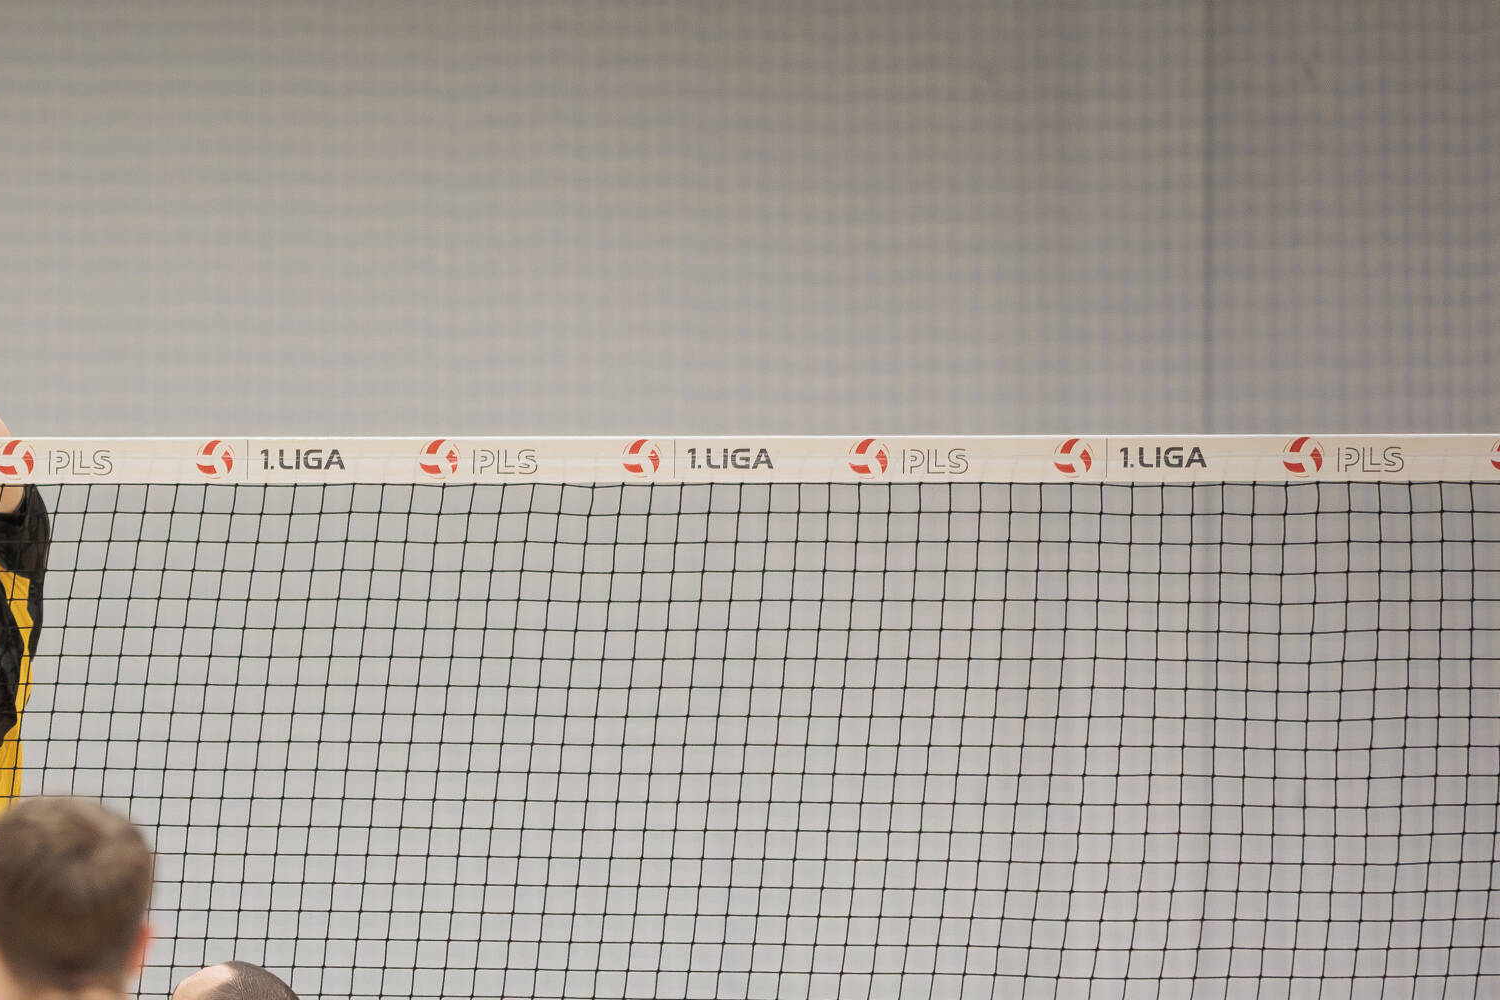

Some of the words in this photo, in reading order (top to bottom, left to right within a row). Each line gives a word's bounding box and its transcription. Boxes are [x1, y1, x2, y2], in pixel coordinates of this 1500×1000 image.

[48, 449, 114, 476] PLS
[472, 448, 539, 475] PLS
[902, 447, 969, 475] PLS
[1336, 445, 1405, 473] PLS
